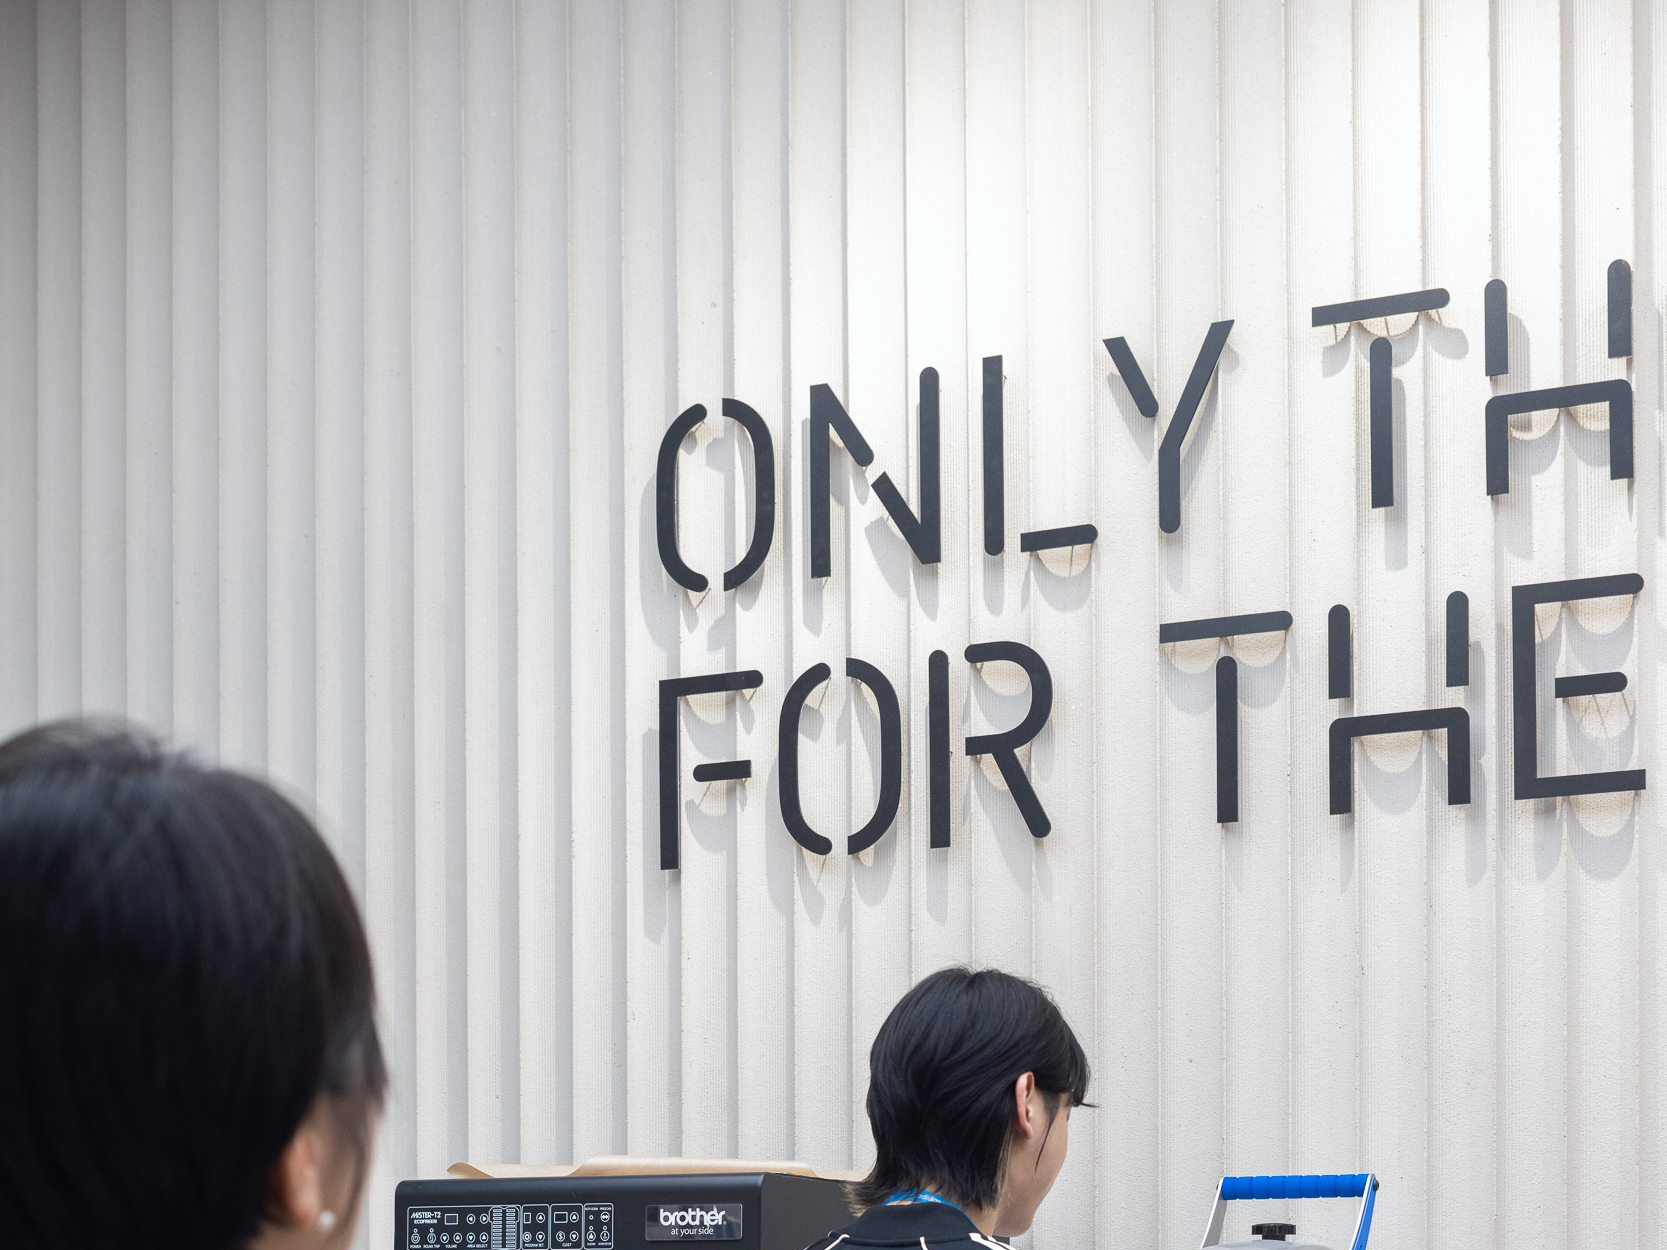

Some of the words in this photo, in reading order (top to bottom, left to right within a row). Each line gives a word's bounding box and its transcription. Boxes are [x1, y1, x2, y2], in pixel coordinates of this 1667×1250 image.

[656, 319, 1235, 593] ONLY
[1312, 258, 1635, 509] TH
[658, 640, 1054, 870] FOR
[1158, 572, 1647, 825] THE
[660, 1208, 726, 1226] brother
[671, 1227, 679, 1235] at
[680, 1228, 697, 1237] your
[698, 1227, 714, 1235] side
